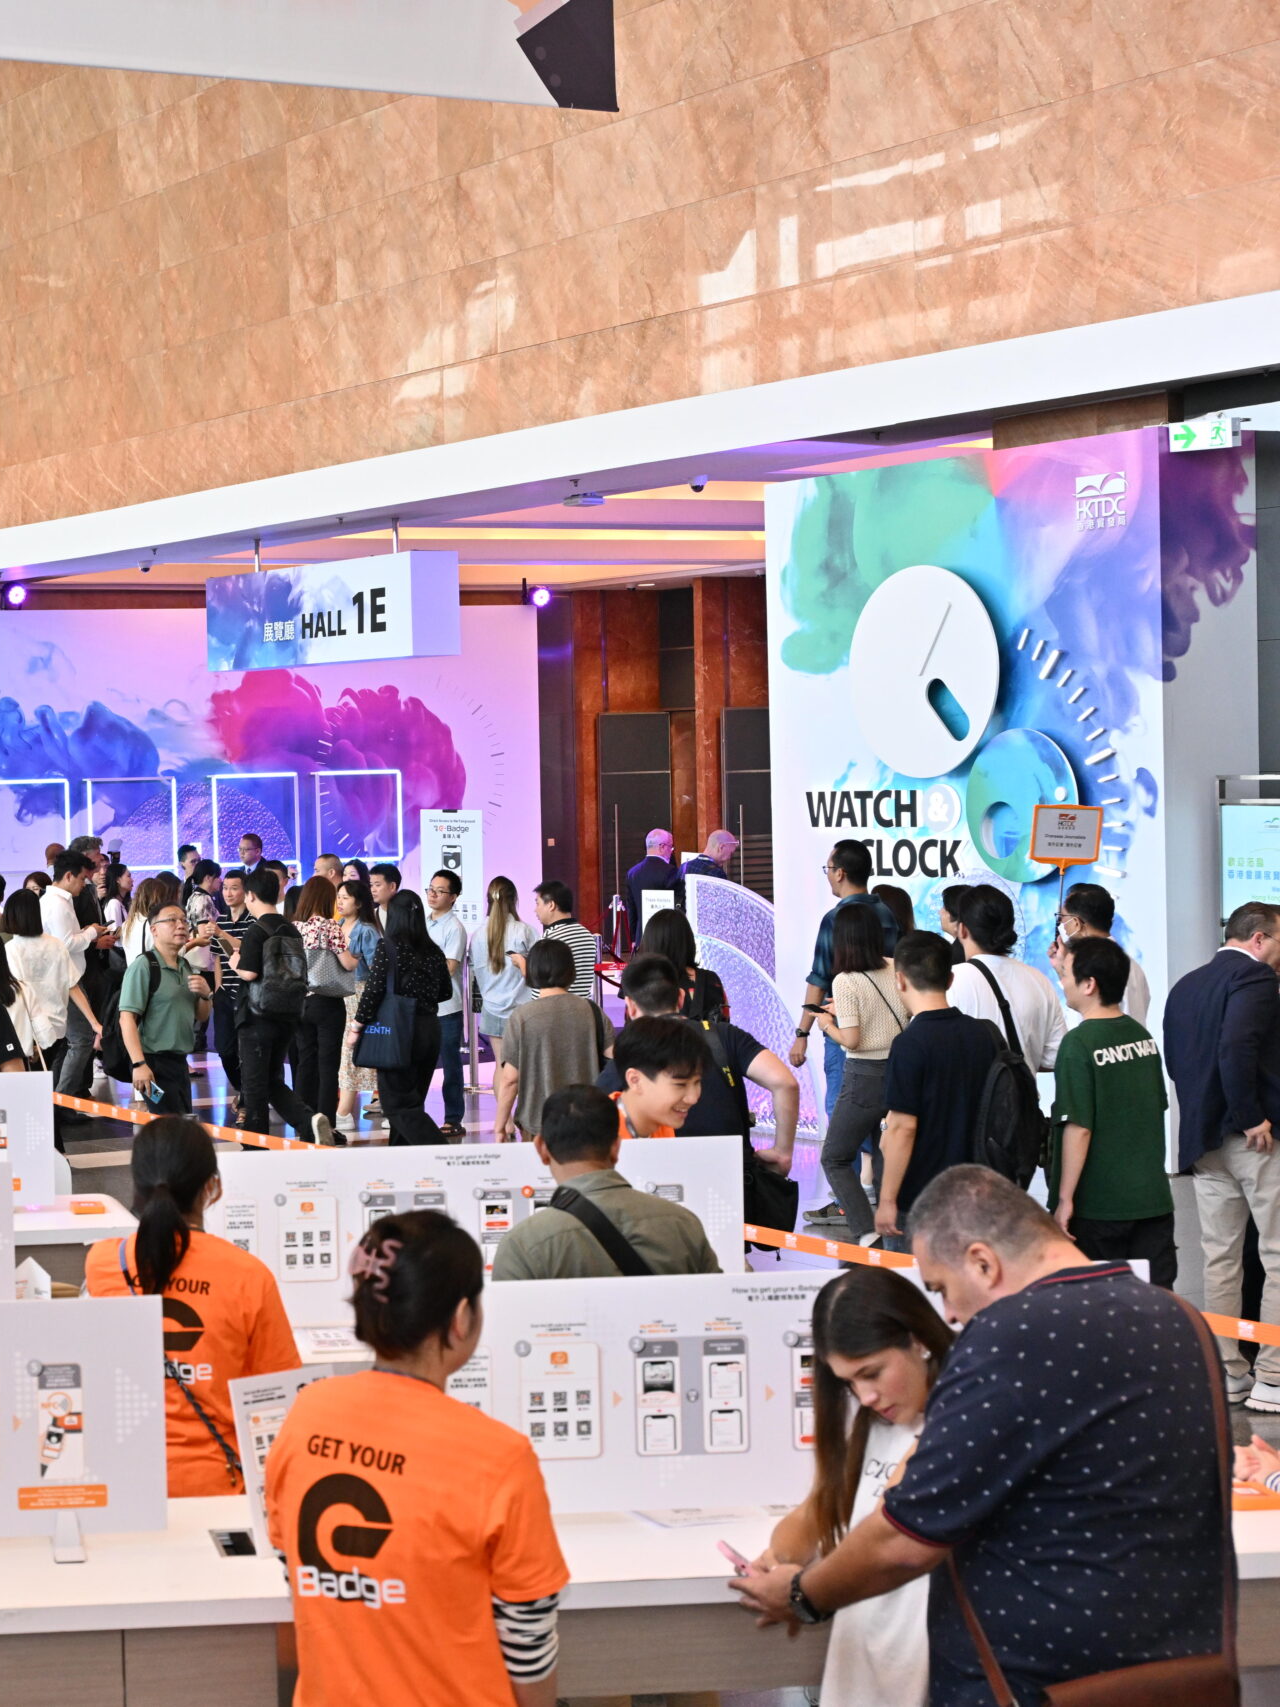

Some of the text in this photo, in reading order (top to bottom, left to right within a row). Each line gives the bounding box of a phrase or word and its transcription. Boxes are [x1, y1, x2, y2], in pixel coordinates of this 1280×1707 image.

[1076, 496, 1126, 521] HKTDC
[263, 587, 387, 642] 展覽廳 HALL 1E
[806, 789, 950, 828] WATCH &
[365, 1026, 391, 1035] ZENITH
[167, 1277, 210, 1295] YOUR
[165, 1358, 212, 1385] dge
[307, 1435, 406, 1475] GET YOUR
[296, 1566, 407, 1610] Badge
